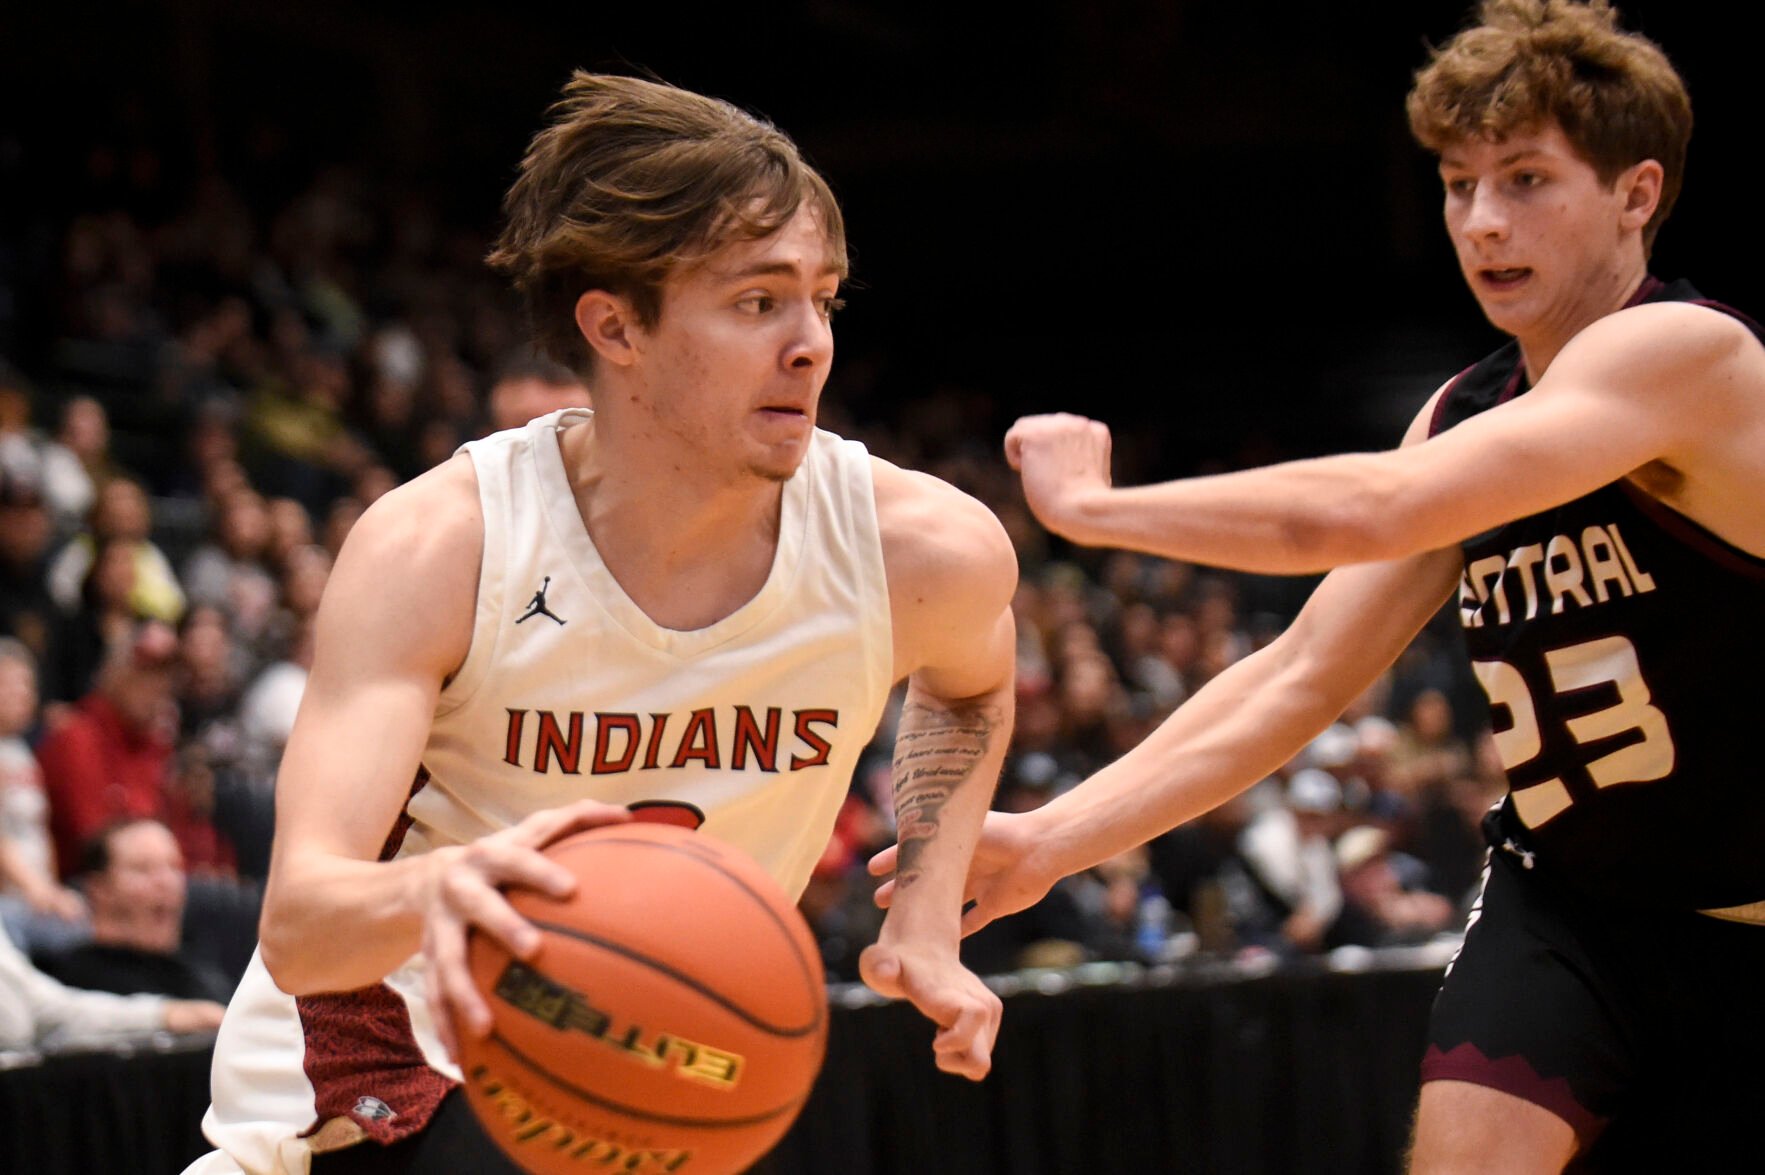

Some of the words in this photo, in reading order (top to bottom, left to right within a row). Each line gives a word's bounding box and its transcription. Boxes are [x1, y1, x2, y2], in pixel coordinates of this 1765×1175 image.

[502, 705, 839, 775] INDIANS
[1471, 635, 1675, 830] 23
[563, 995, 745, 1092] ELITE
